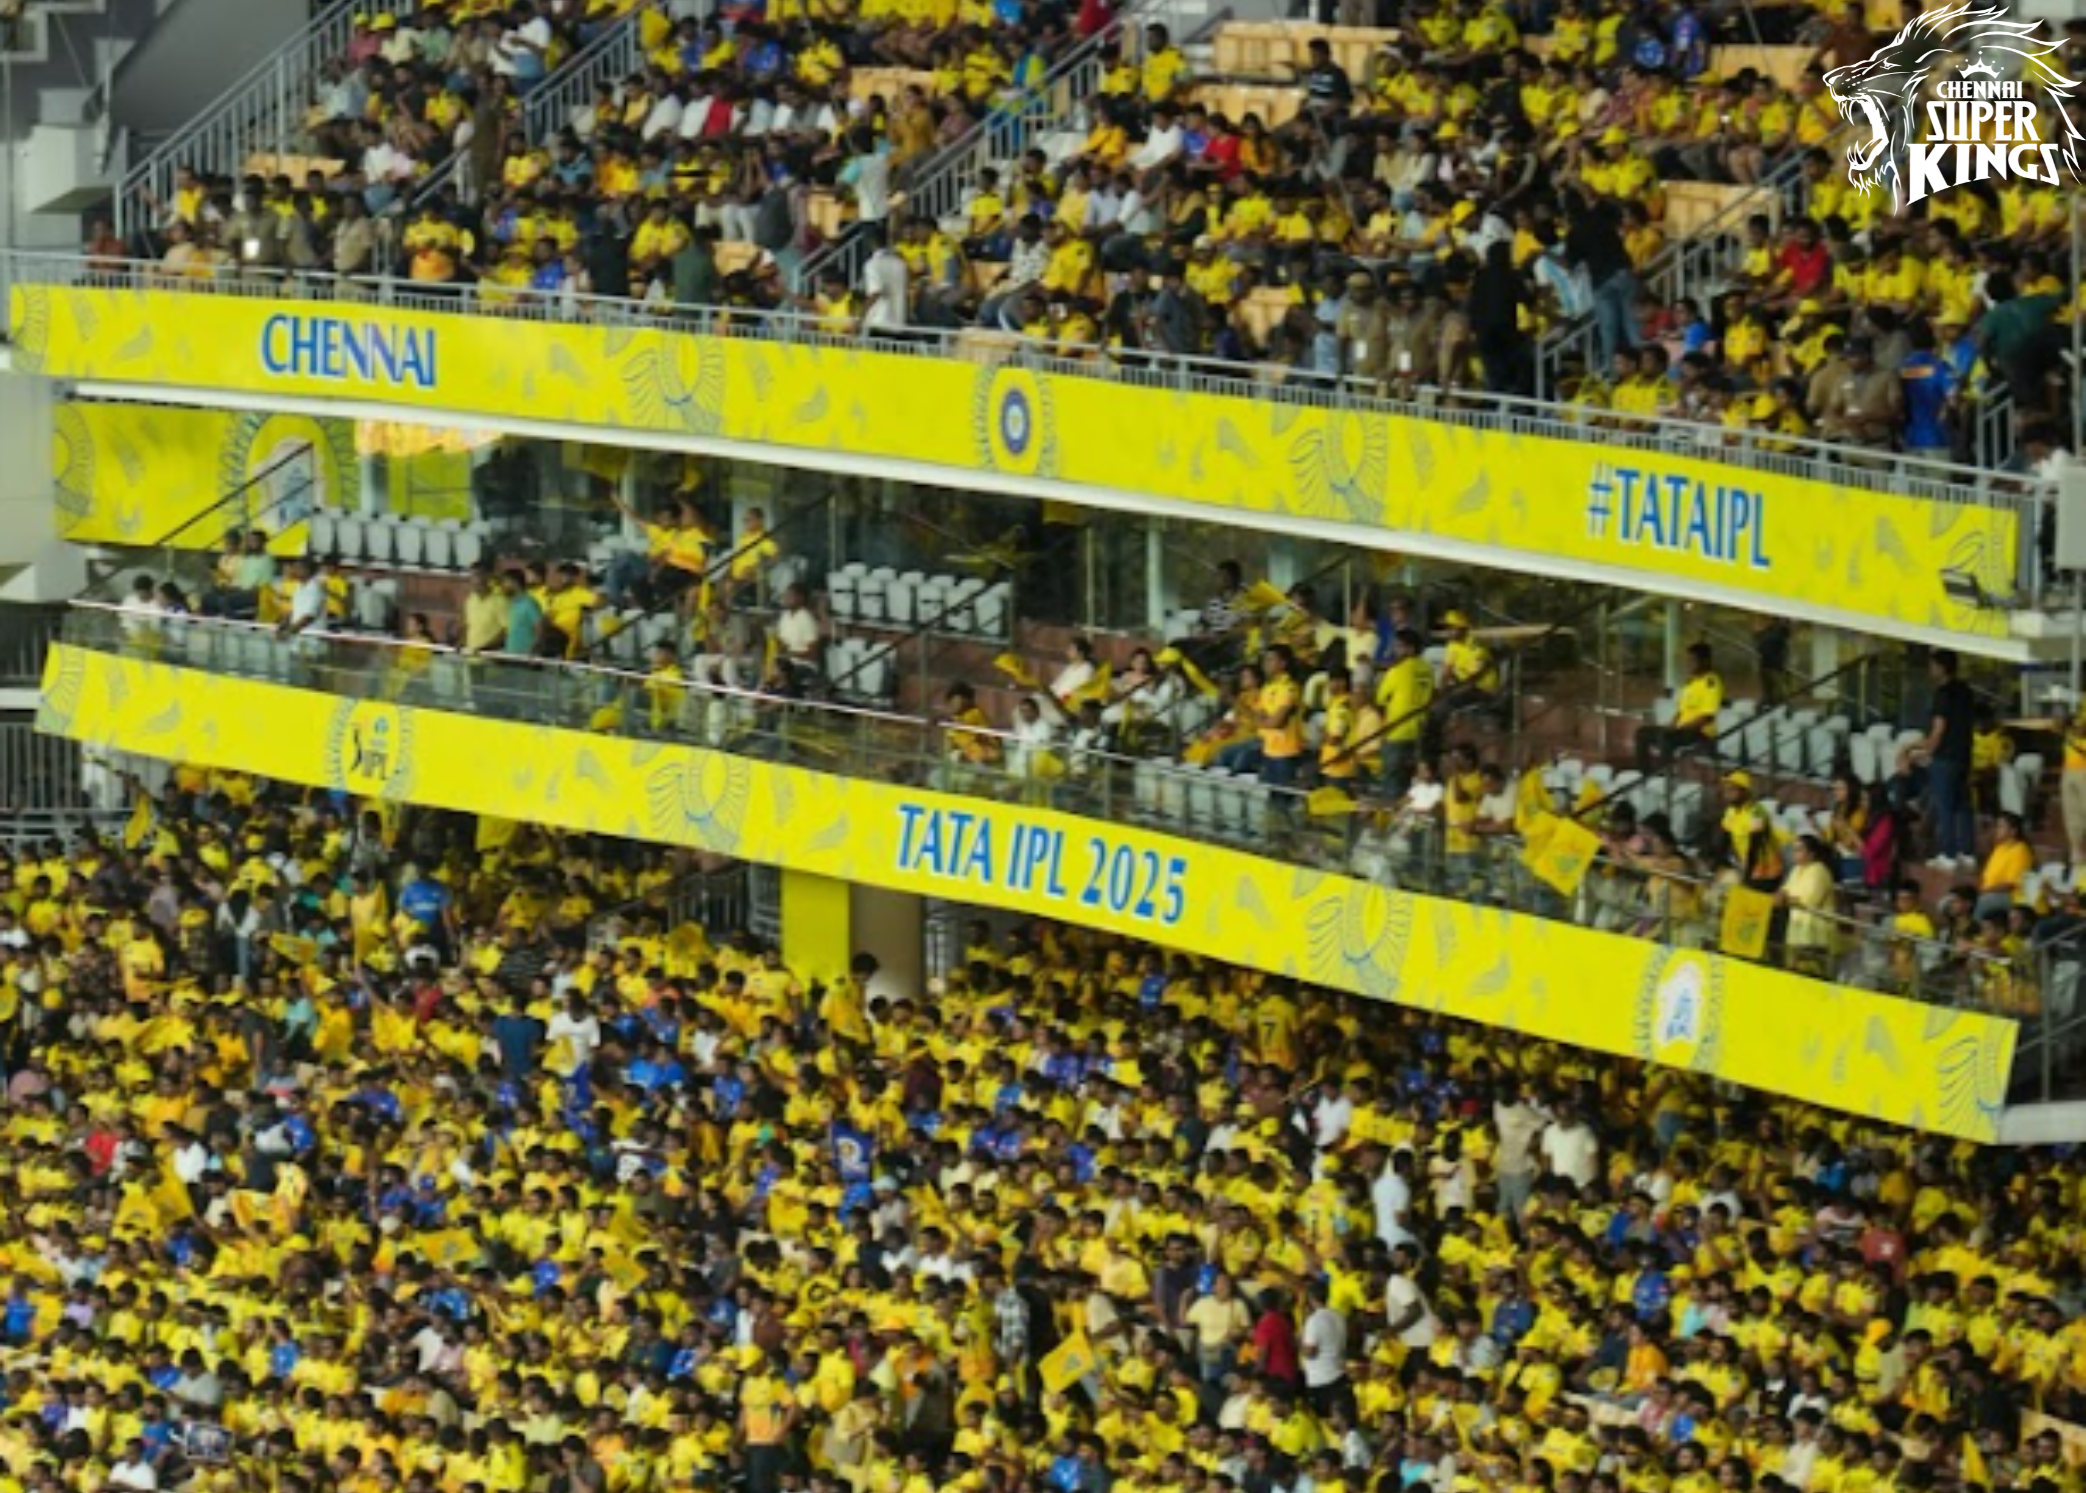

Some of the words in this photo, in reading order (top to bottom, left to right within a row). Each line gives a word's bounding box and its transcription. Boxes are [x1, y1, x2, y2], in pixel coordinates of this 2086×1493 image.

[261, 312, 436, 387] CHENNAI
[1587, 460, 1771, 568] #TATAIPL
[898, 803, 992, 882] TATA
[1007, 822, 1067, 897] IPL
[1081, 837, 1187, 924] 2025
